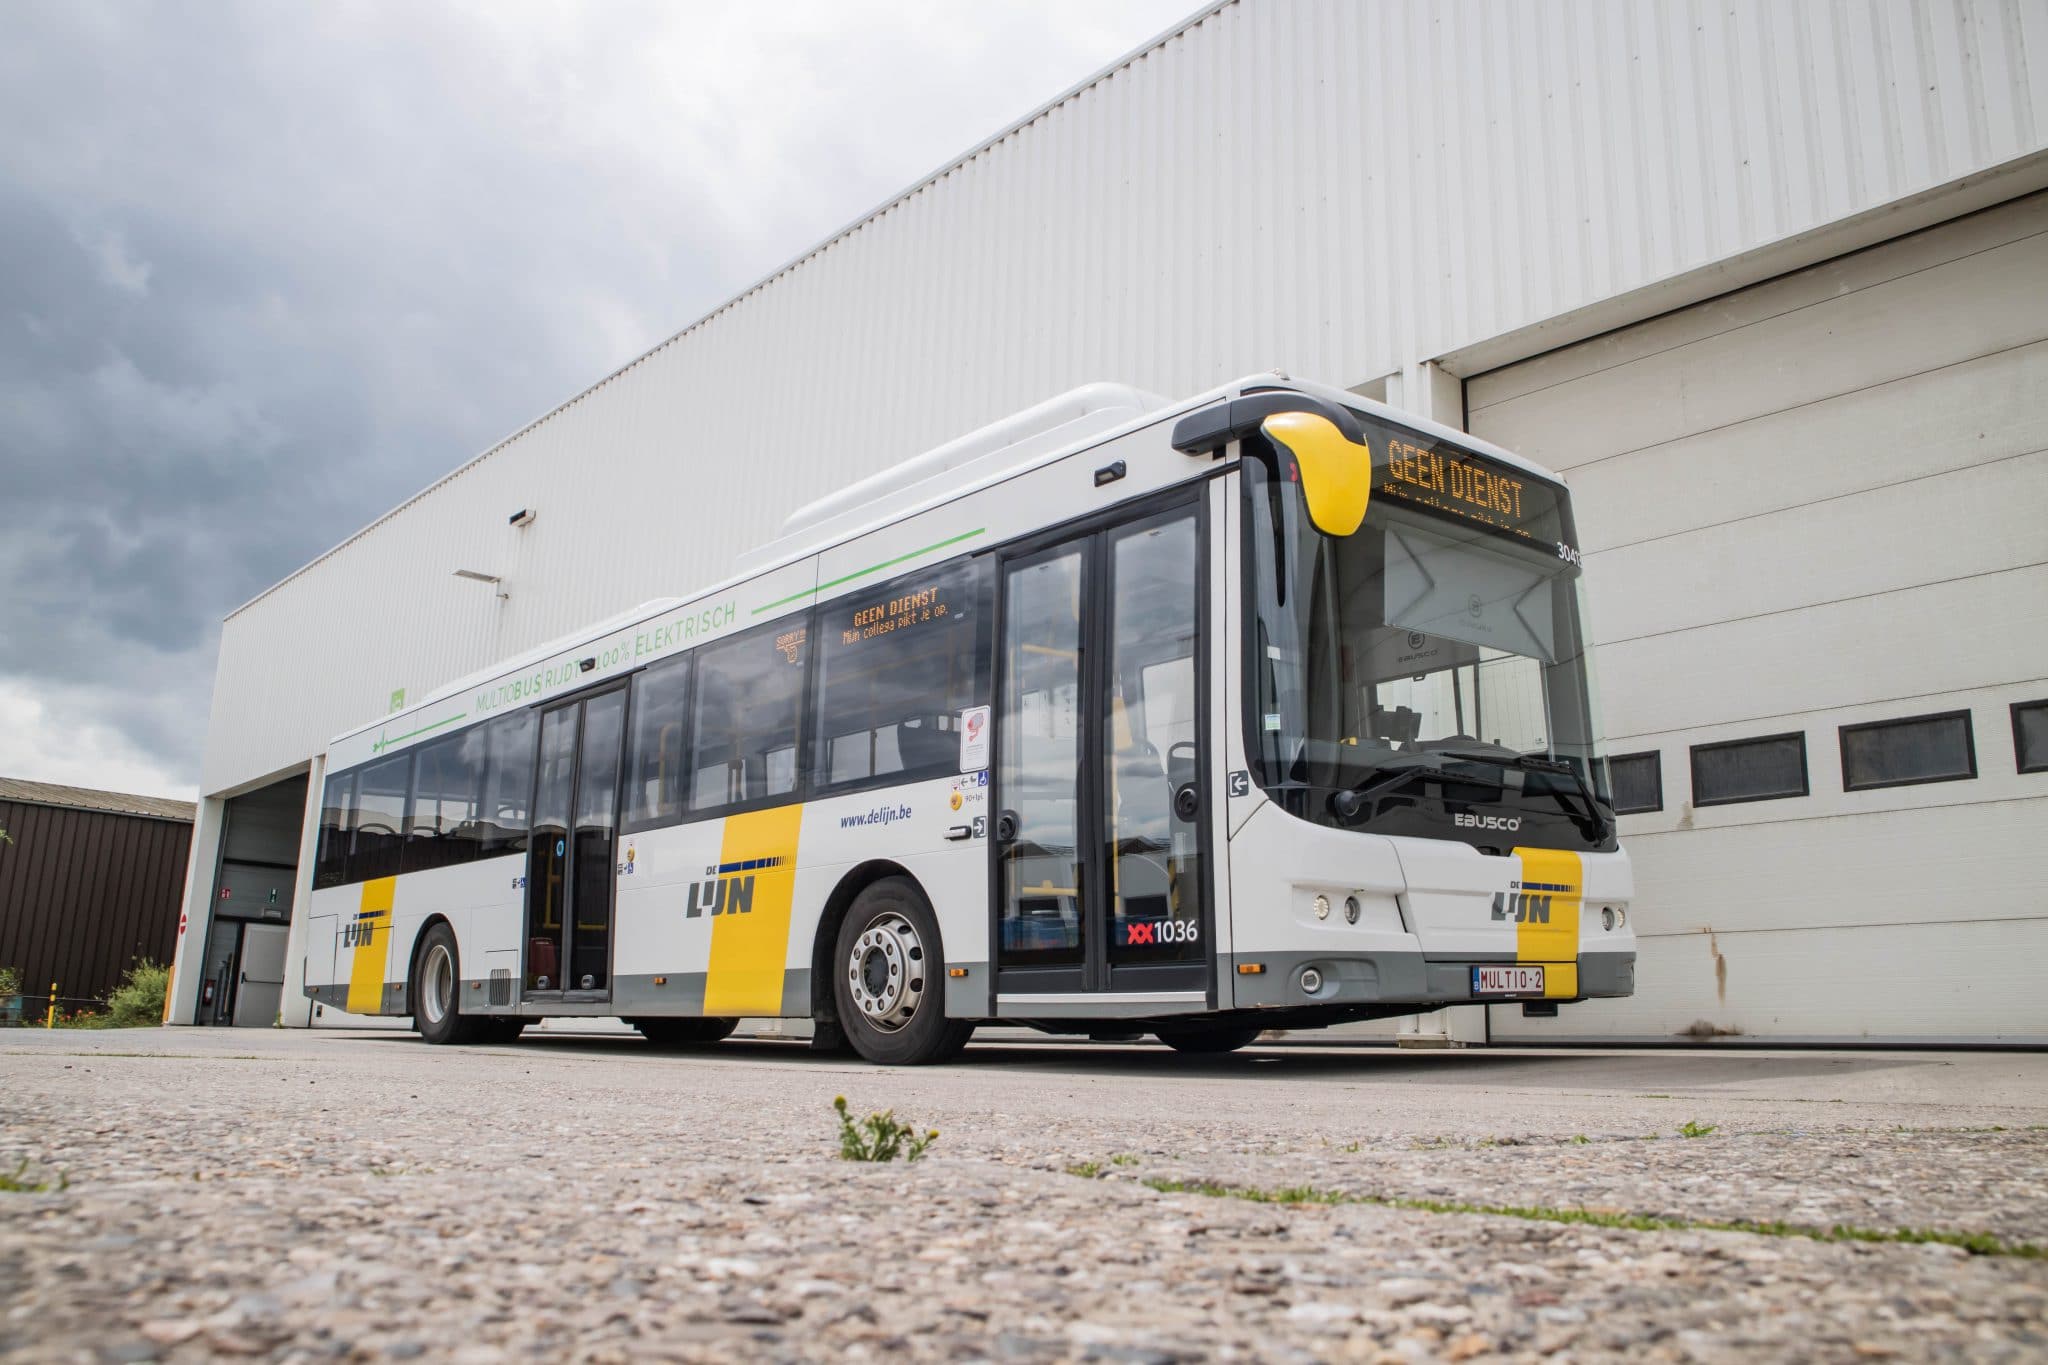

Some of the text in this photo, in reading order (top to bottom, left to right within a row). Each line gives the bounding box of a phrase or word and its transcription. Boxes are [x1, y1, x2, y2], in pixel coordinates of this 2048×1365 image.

[1388, 439, 1445, 494] GEEN
[1450, 459, 1523, 518] DIENST
[854, 586, 938, 627] GEEN DIENST
[476, 672, 542, 713] MULTIOBUS
[596, 641, 630, 672] 100%
[635, 601, 736, 657] ELEKTRISCH
[841, 804, 912, 828] www.delijn.be
[1455, 813, 1520, 831] EBUSCO
[706, 865, 717, 875] DE
[686, 875, 755, 918] LIJN
[1510, 881, 1520, 889] DE
[1491, 892, 1552, 923] LIJN
[344, 922, 374, 947] LIJN
